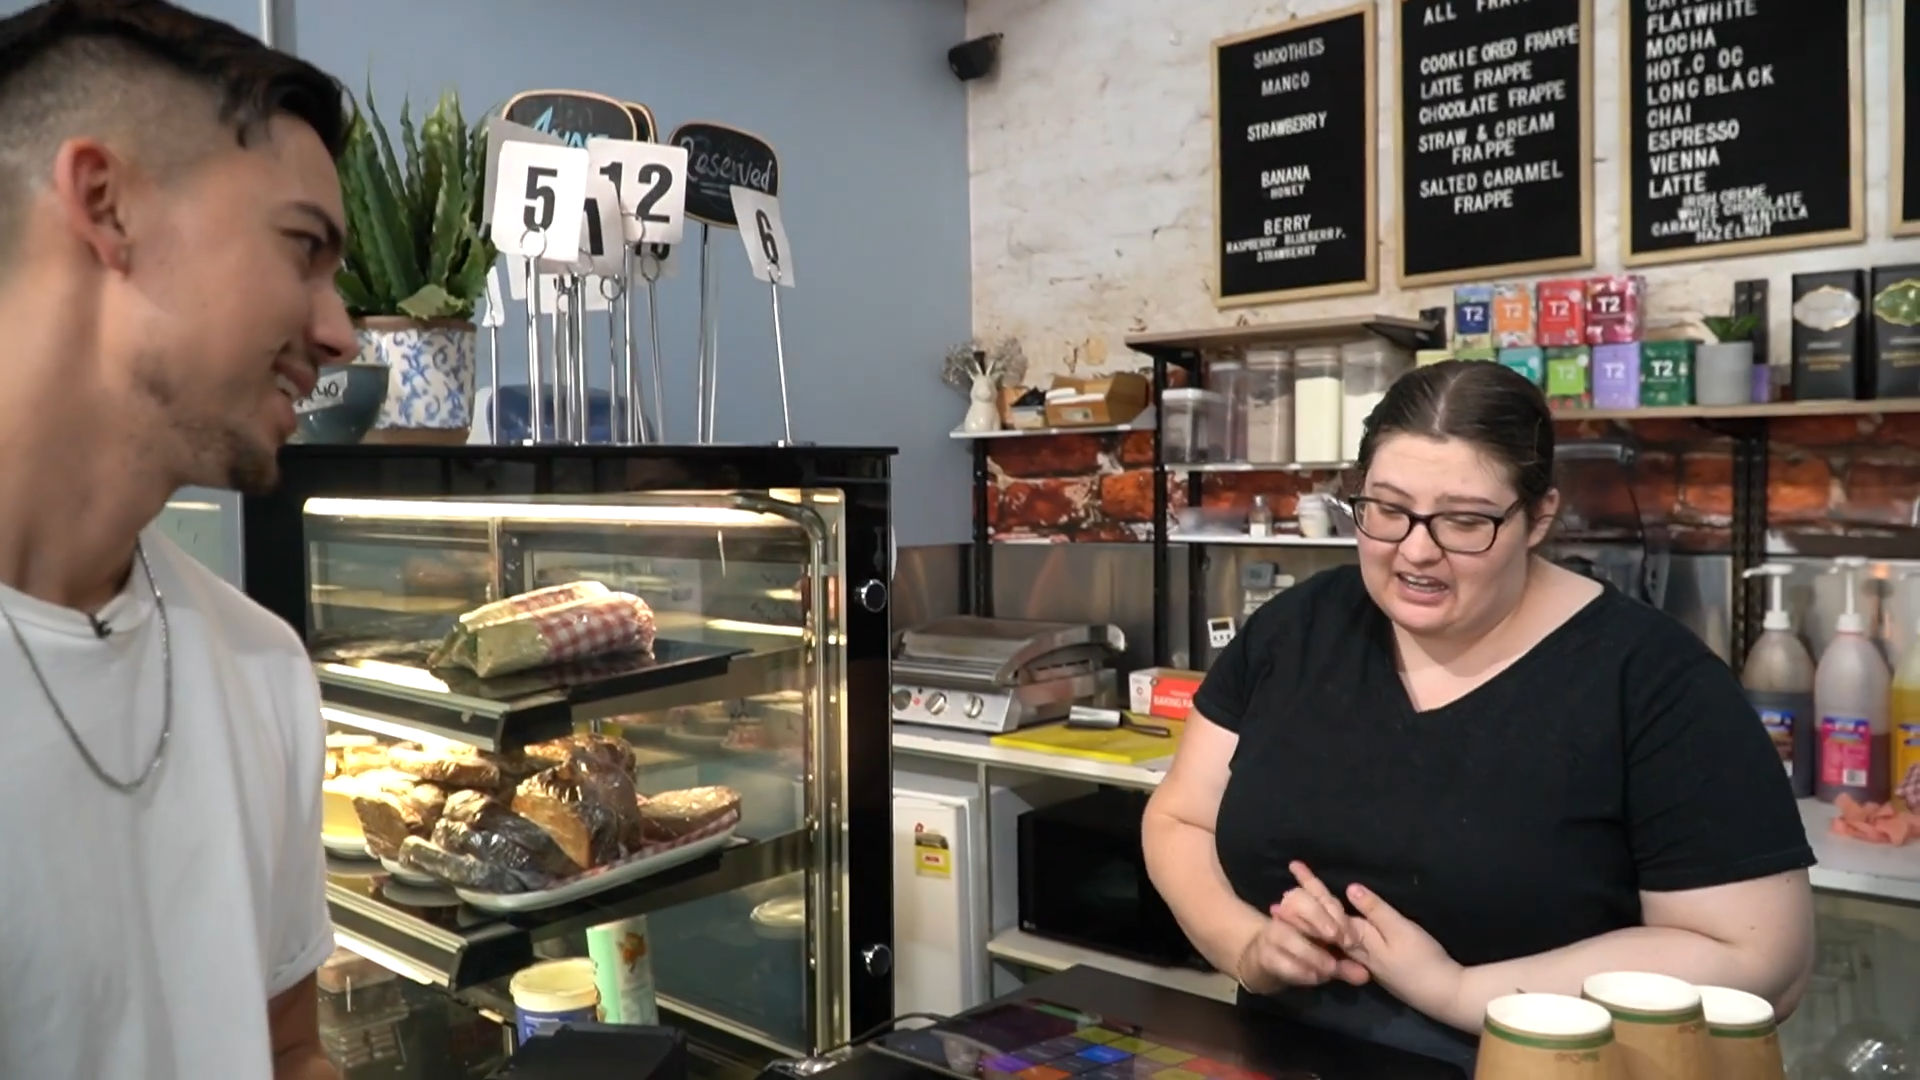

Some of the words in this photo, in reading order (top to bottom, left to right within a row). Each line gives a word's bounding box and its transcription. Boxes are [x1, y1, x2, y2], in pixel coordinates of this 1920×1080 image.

[1423, 1, 1457, 25] ALL
[1646, 0, 1758, 35] FLATWHITE
[1254, 37, 1325, 69] SMOOTHIES
[1420, 46, 1478, 75] COOKIE
[1524, 23, 1580, 53] FRAPPE
[1646, 27, 1717, 60] MOCHA
[1261, 71, 1311, 96] MANGO
[1420, 75, 1464, 99] LATTE
[1474, 61, 1533, 89] FRAPPE
[1646, 78, 1700, 106] LONG
[1704, 64, 1775, 96] BLACK
[1419, 92, 1499, 125] CHOCOLATE
[1508, 80, 1566, 108] FRAPPE
[1647, 102, 1691, 129] CHAI
[1247, 111, 1328, 142] STRAWBERRY
[1418, 128, 1467, 153] STRAW
[1476, 124, 1488, 142] &
[1495, 111, 1555, 140] CREAM
[1648, 118, 1740, 152] ESPRESSO
[1452, 138, 1516, 164] FRAPPE
[1649, 146, 1720, 175] VIENNA
[1261, 165, 1311, 188] BANANA
[1419, 172, 1477, 198] SALTED
[1483, 159, 1564, 189] CARAMEL
[1648, 171, 1707, 199] LATTE
[523, 166, 558, 233] 5
[600, 161, 673, 224] 12
[1270, 184, 1305, 199] HONEY
[1454, 189, 1513, 214] FRAPPE
[756, 208, 779, 264] 6
[1264, 213, 1311, 236] BERRY
[1695, 220, 1771, 243] HAZELNUT
[1464, 306, 1484, 321] T2
[1503, 303, 1523, 318] T2
[1550, 300, 1570, 316] T2
[1600, 296, 1620, 312] T2
[1557, 365, 1577, 380] T2
[1604, 362, 1625, 378] T2
[1652, 360, 1673, 376] T2
